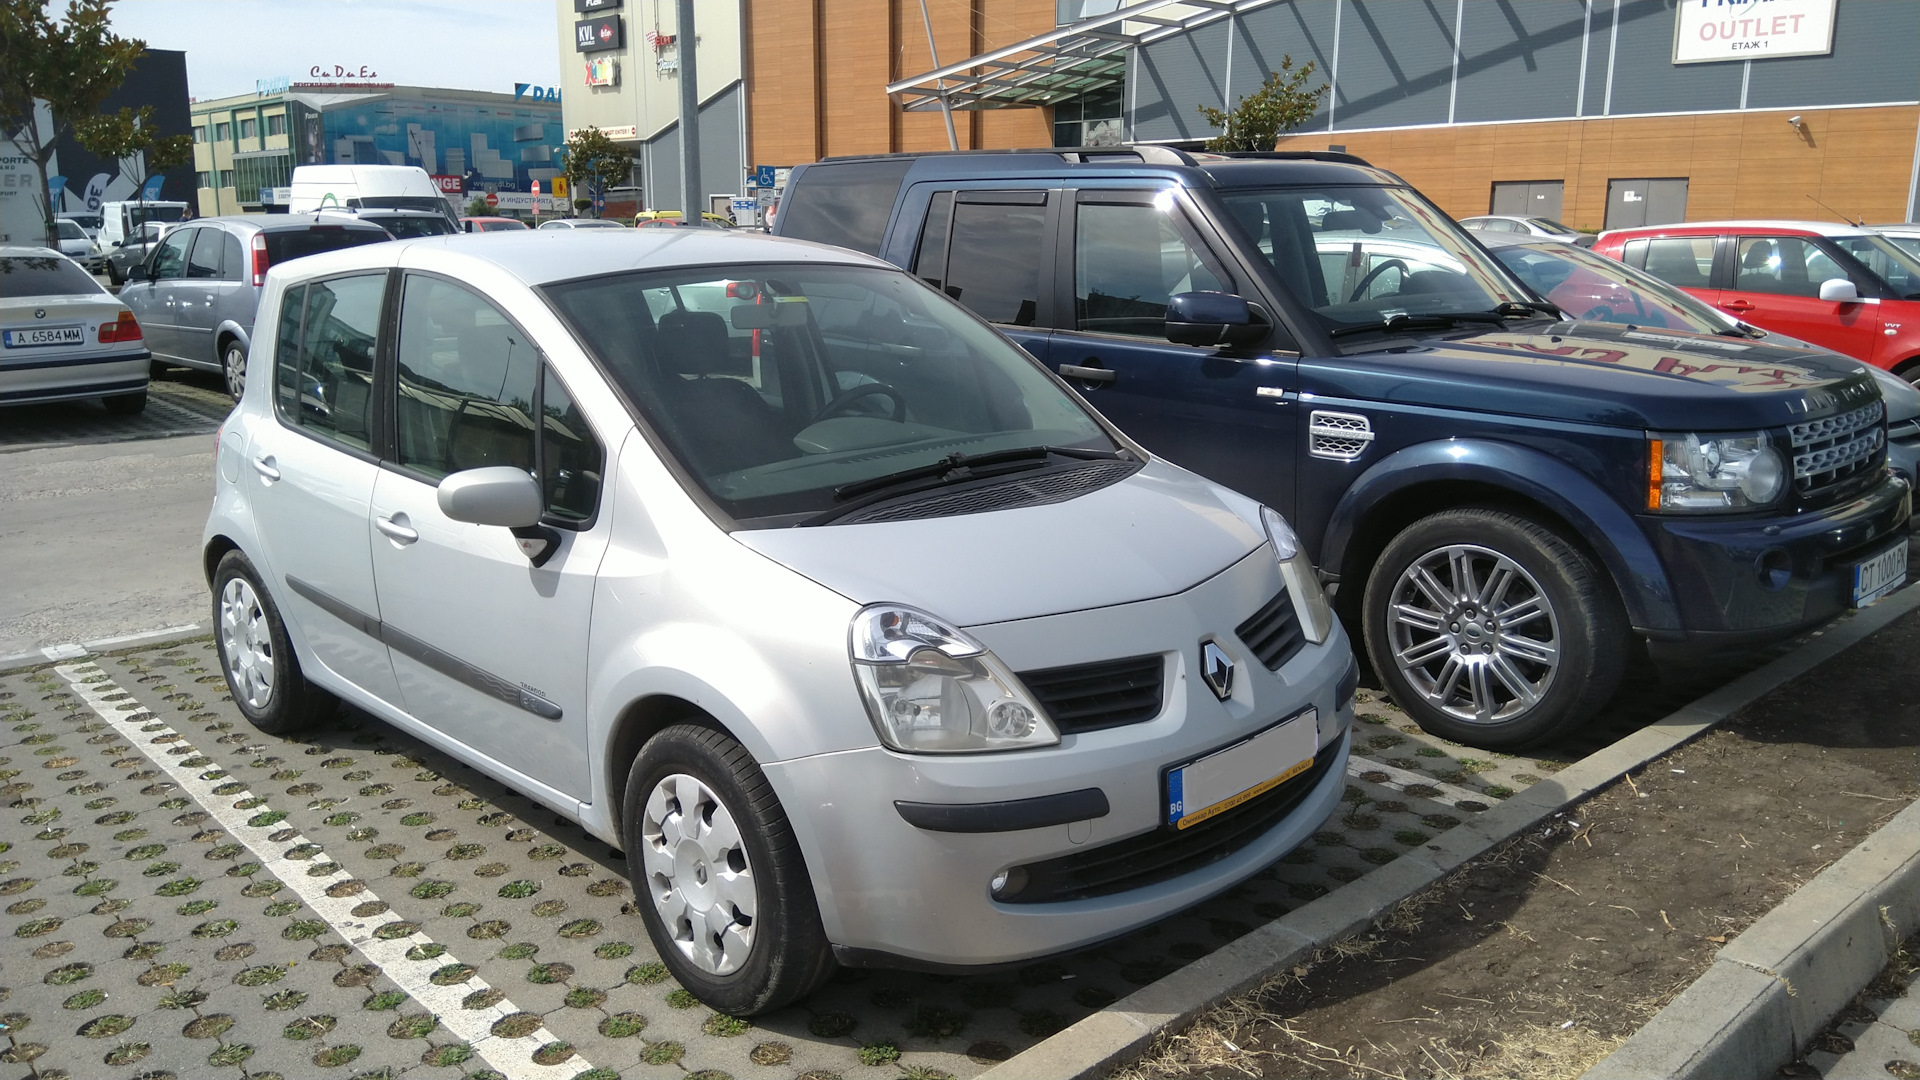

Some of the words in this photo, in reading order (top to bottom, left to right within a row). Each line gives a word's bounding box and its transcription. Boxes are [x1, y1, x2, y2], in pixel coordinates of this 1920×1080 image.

[579, 25, 595, 41] KVL
[1699, 14, 1805, 41] OUTLET
[1731, 41, 1760, 50] ЕТАЖ
[32, 331, 62, 343] 6584
[1861, 563, 1875, 593] CT
[1170, 800, 1182, 815] BG
